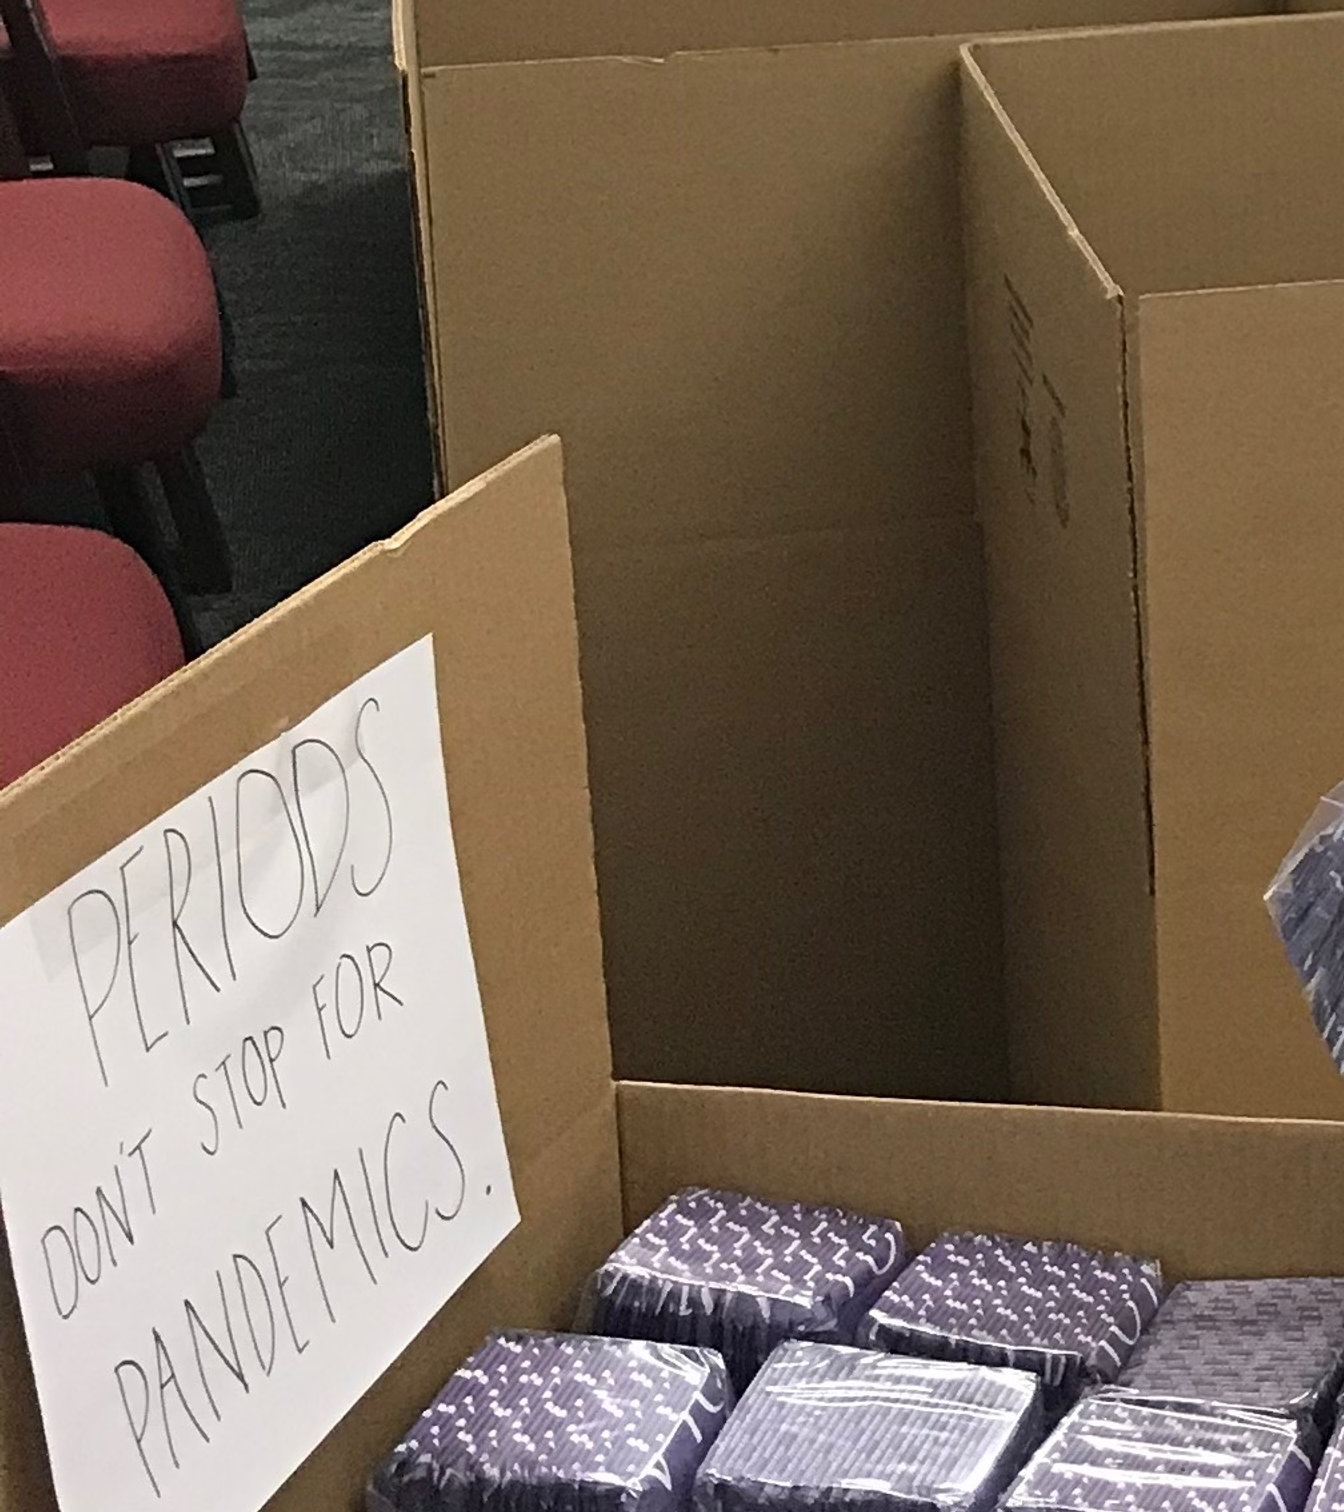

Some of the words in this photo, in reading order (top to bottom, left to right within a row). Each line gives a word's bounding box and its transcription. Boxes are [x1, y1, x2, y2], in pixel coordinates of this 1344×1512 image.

[66, 697, 395, 1088] PERIODS
[41, 1128, 157, 1320] DON'T
[195, 1024, 287, 1157] STOP
[313, 941, 404, 1061] FOR
[114, 1079, 494, 1499] PANDEMICS.
